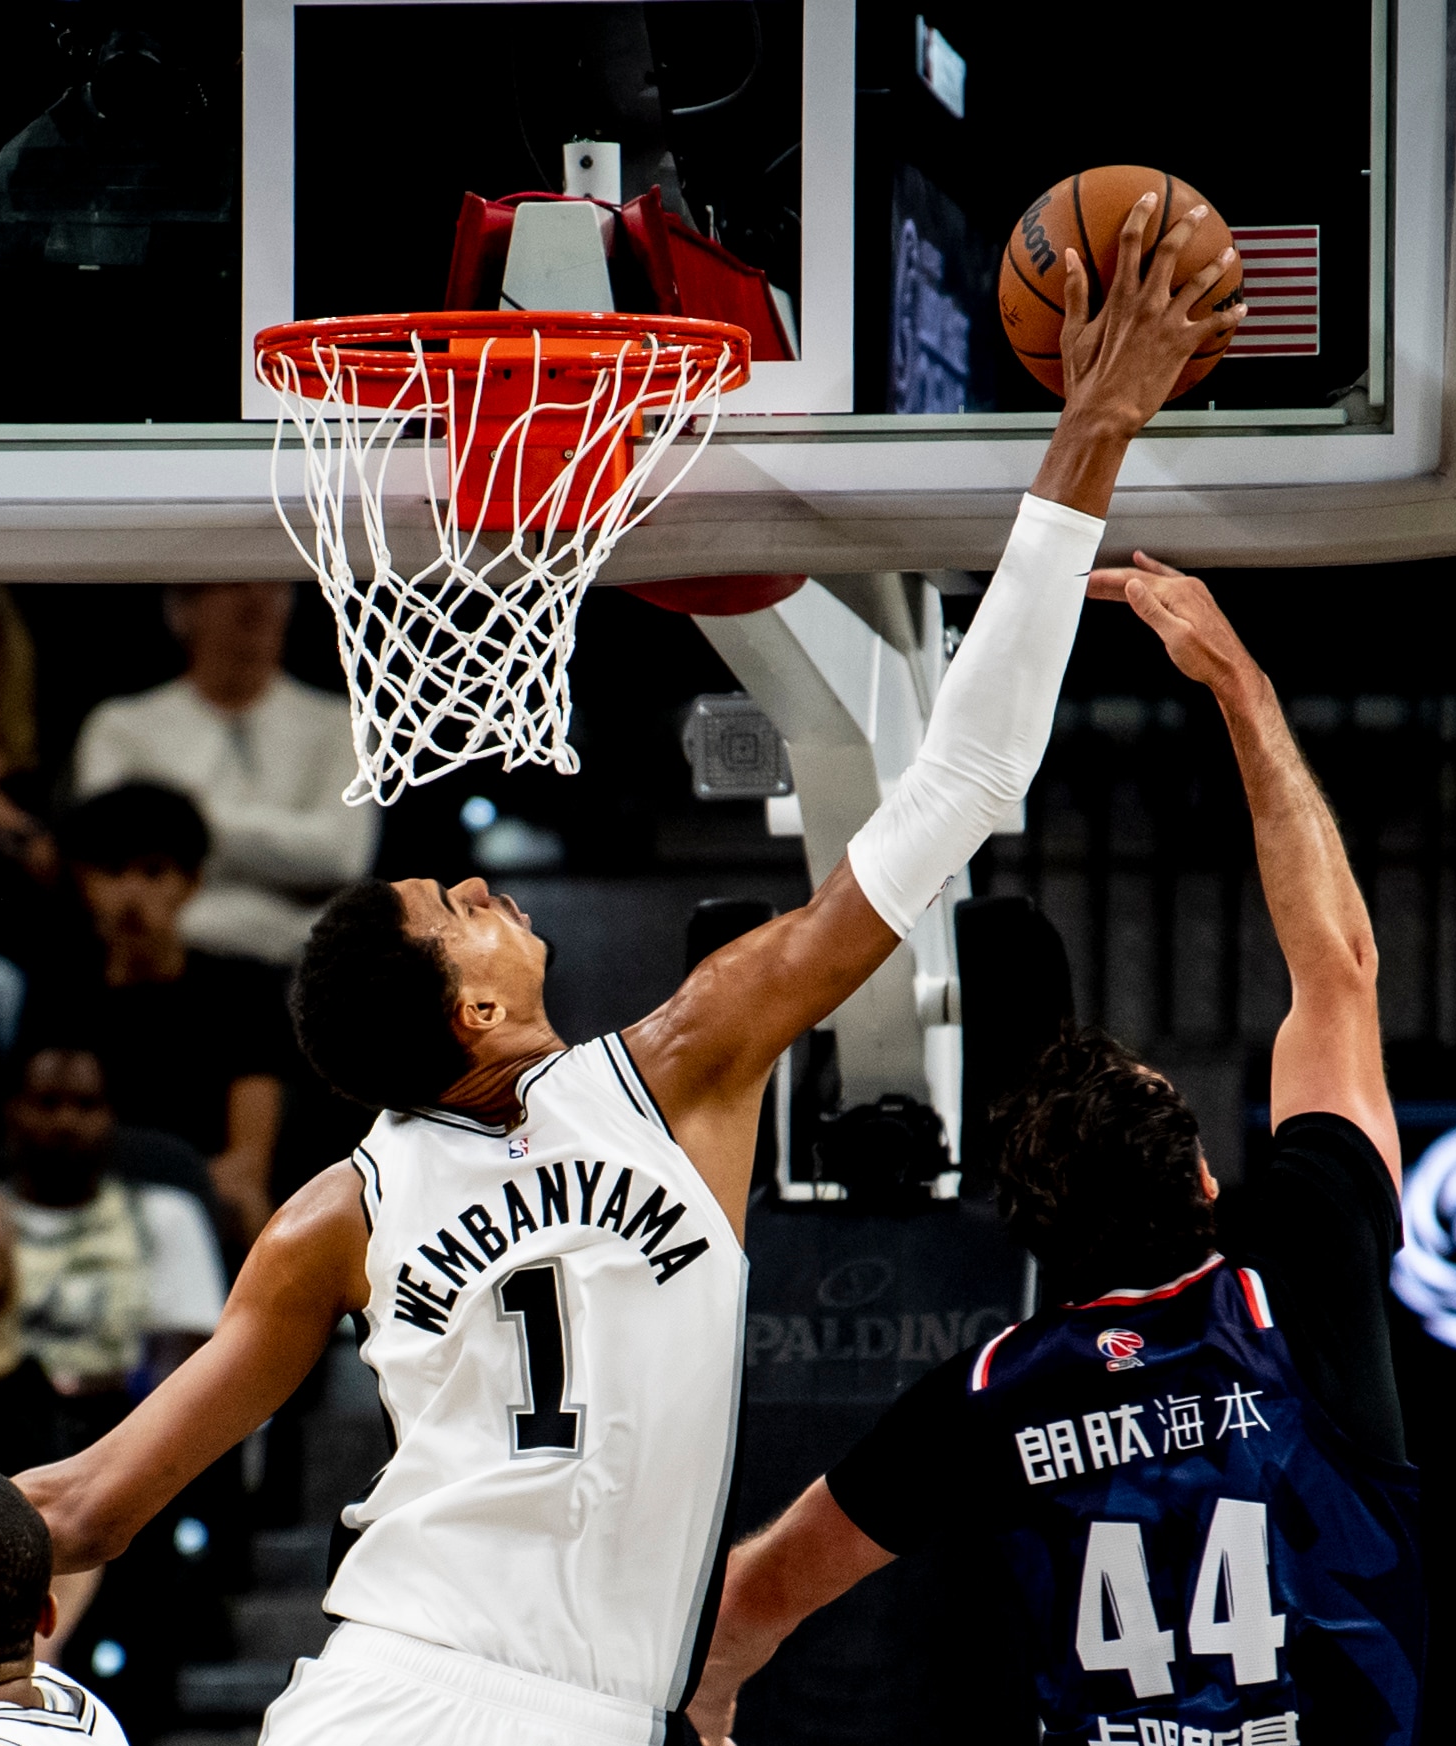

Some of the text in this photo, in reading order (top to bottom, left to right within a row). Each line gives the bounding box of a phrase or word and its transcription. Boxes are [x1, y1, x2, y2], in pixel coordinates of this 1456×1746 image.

[393, 1160, 711, 1336] WEMBANYAMA
[491, 1255, 588, 1461] 1
[745, 1306, 1015, 1367] PALDING
[1014, 1382, 1272, 1486] 朗肽海本
[1075, 1497, 1287, 1699] 44
